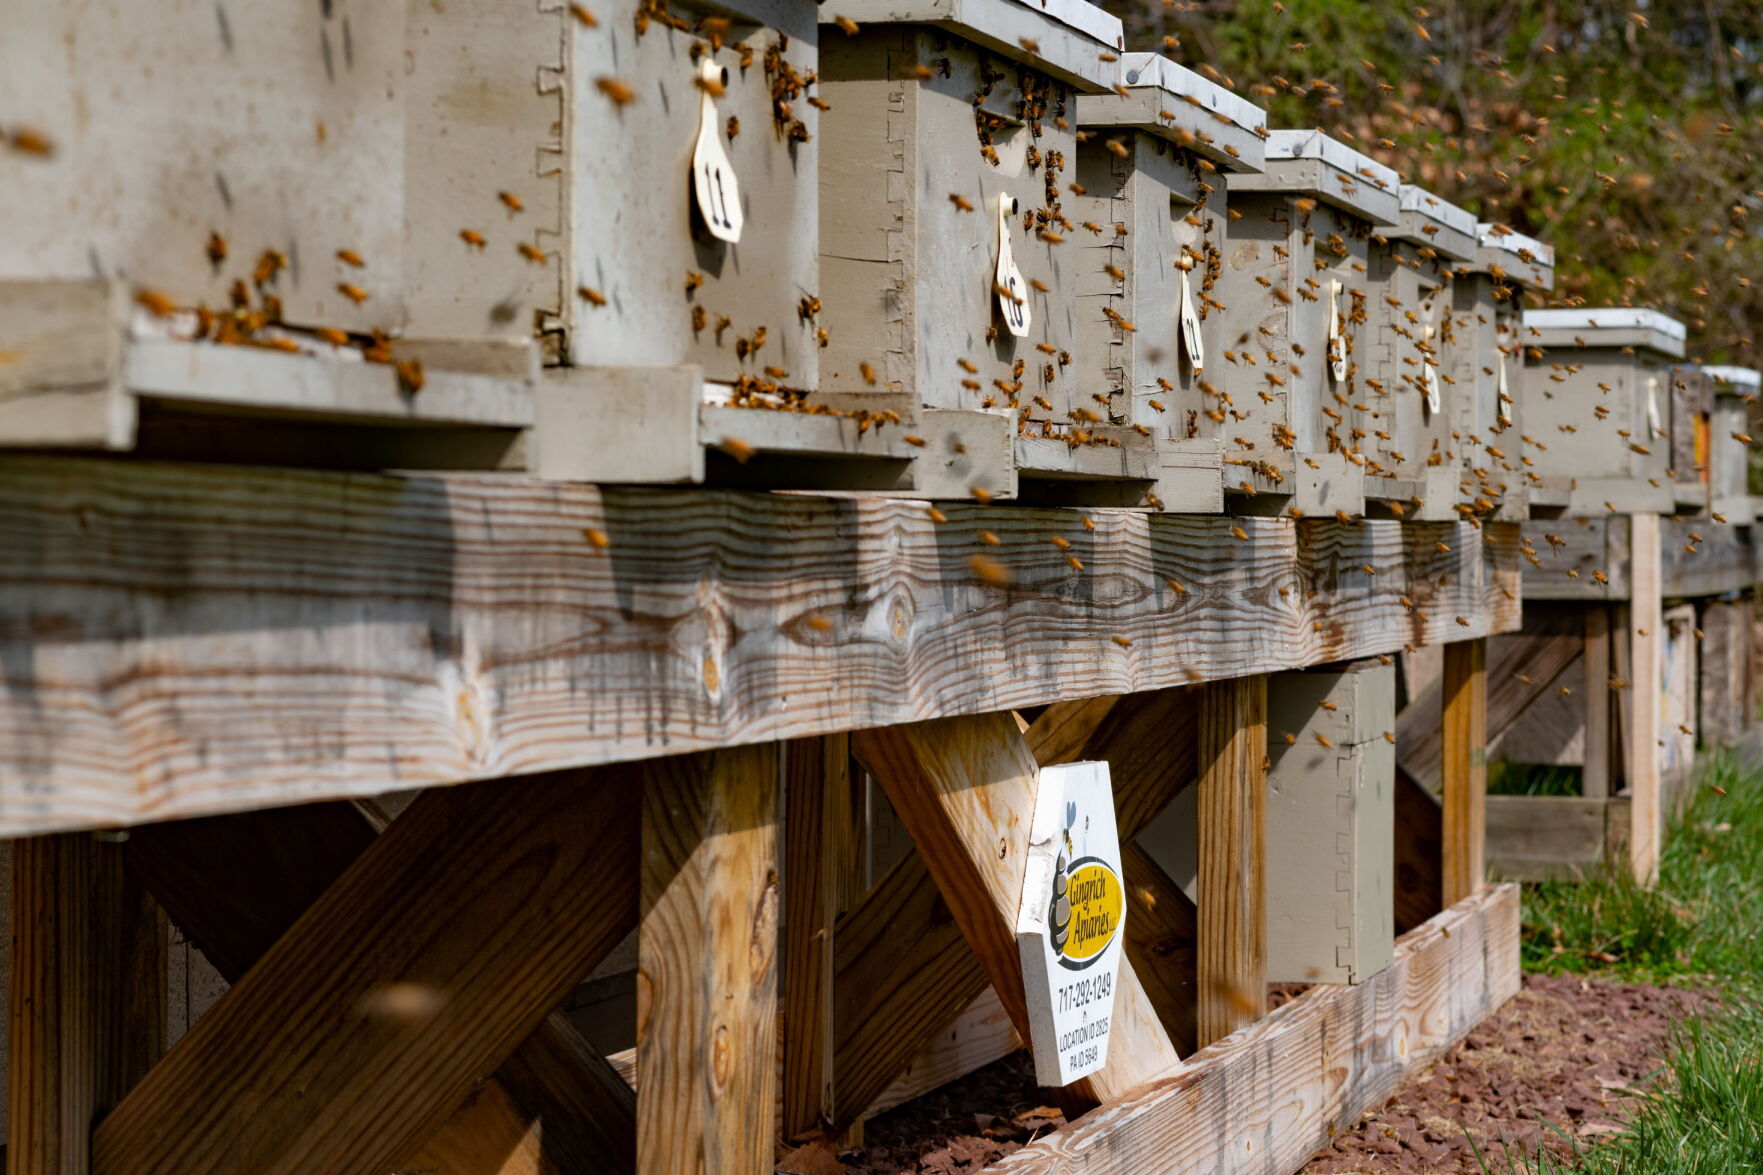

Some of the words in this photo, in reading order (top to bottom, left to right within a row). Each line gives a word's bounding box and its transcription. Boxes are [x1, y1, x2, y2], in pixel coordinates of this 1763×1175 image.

[1069, 869, 1106, 911] Gingrich
[1073, 904, 1110, 950] Apiaries
[1059, 971, 1111, 1014] 717-292-1249
[1060, 1025, 1088, 1053] LOCATION
[1088, 1022, 1095, 1040] ID
[1069, 1054, 1077, 1072] PA
[1078, 1050, 1085, 1069] ID
